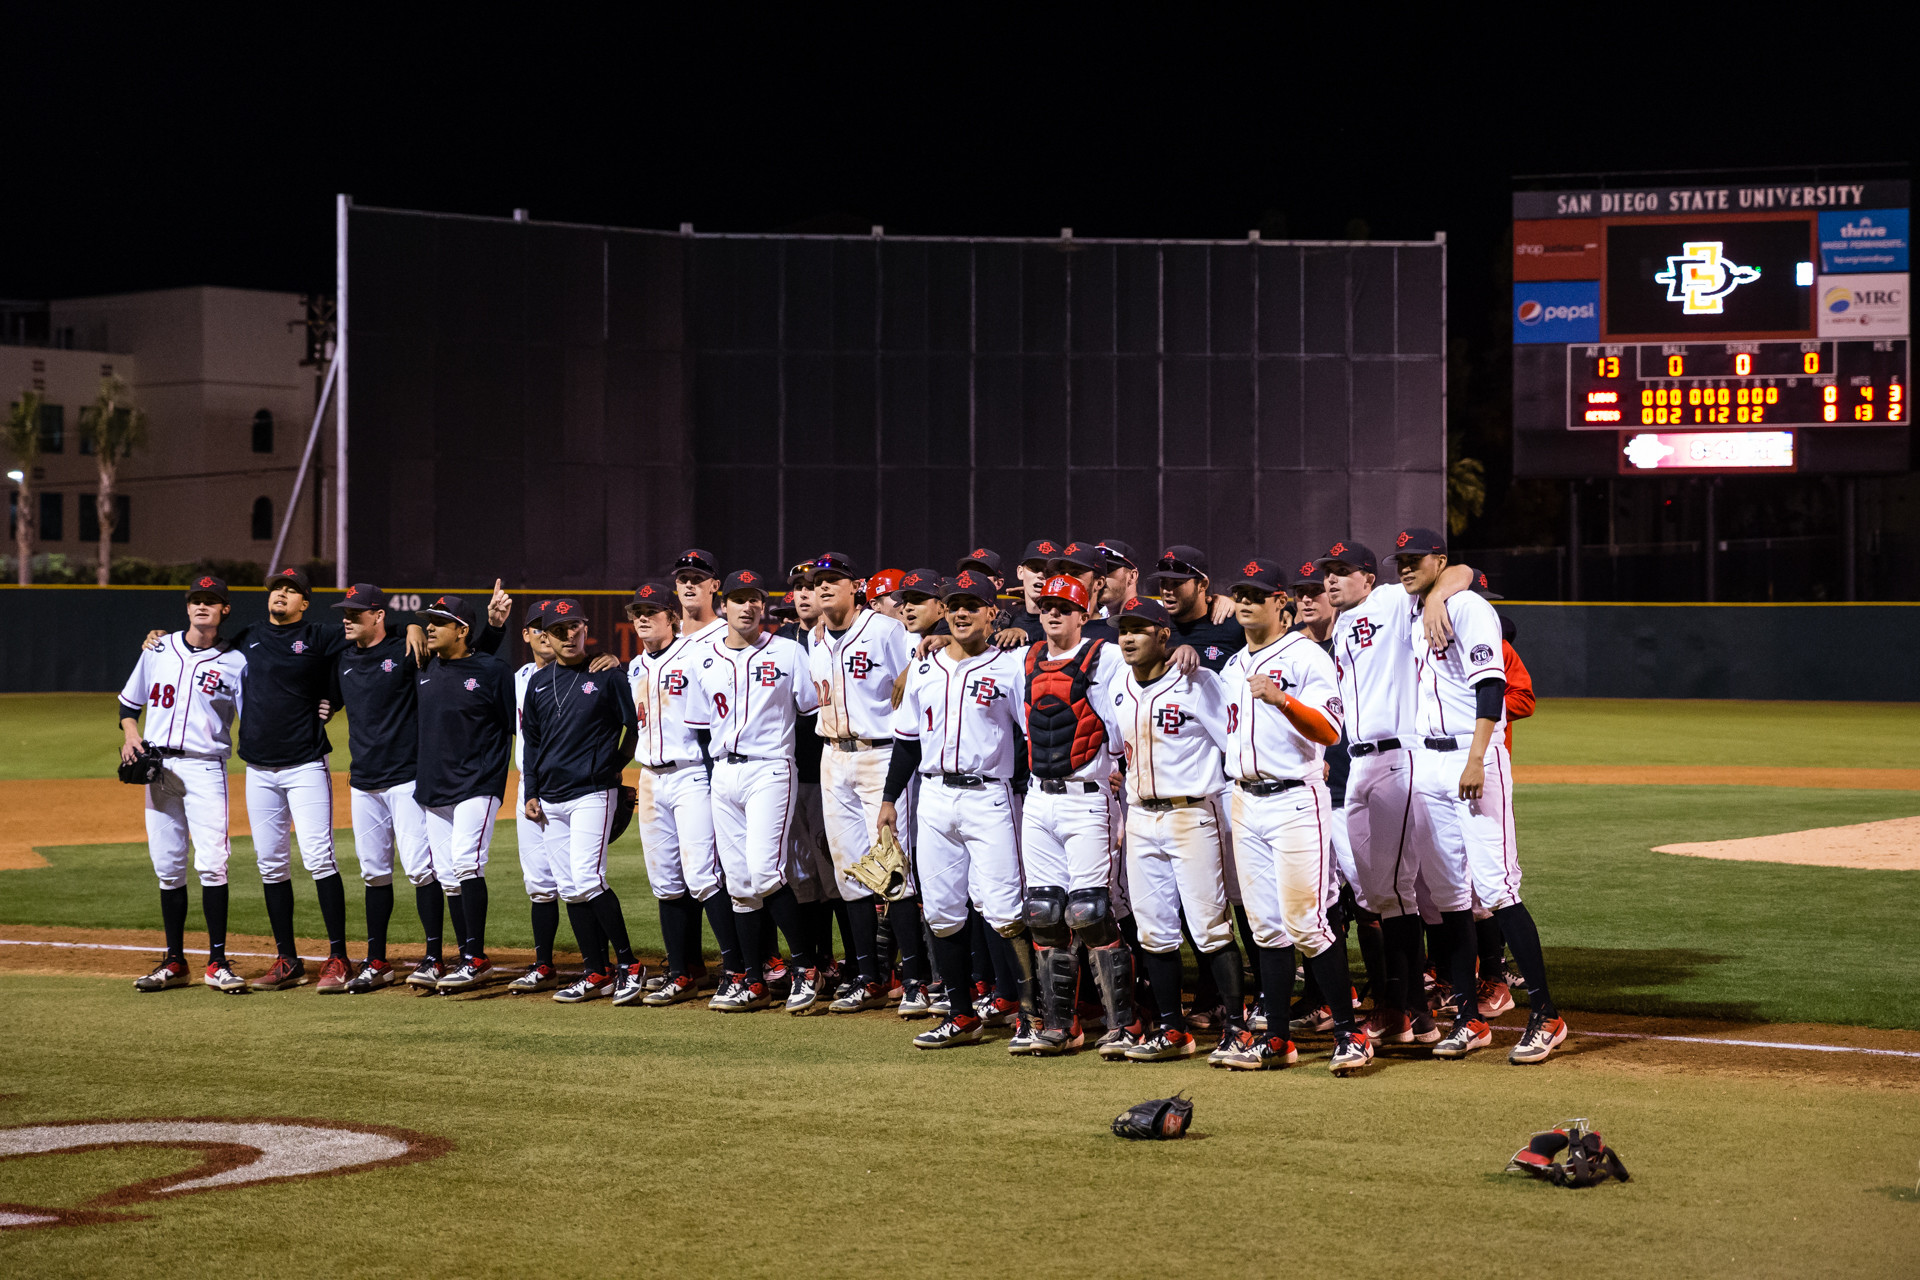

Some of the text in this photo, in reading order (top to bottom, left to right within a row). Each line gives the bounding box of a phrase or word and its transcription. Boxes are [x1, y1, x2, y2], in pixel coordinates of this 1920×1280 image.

[1557, 185, 1864, 214] SAN DIEGO STATE UNIVERSITY
[1840, 222, 1887, 238] thrive
[1854, 288, 1901, 306] MRC
[1544, 302, 1594, 322] pepsi
[1598, 356, 1620, 378] 13
[1668, 355, 1683, 377] 0
[1735, 353, 1751, 376] 0
[1803, 352, 1819, 374] 0
[1860, 386, 1874, 402] 4
[1889, 384, 1902, 403] 3
[1854, 403, 1874, 422] 13
[1888, 402, 1902, 421] 2
[388, 594, 422, 612] 410
[150, 683, 175, 709] 48
[713, 692, 729, 719] 8
[925, 706, 933, 732] 1
